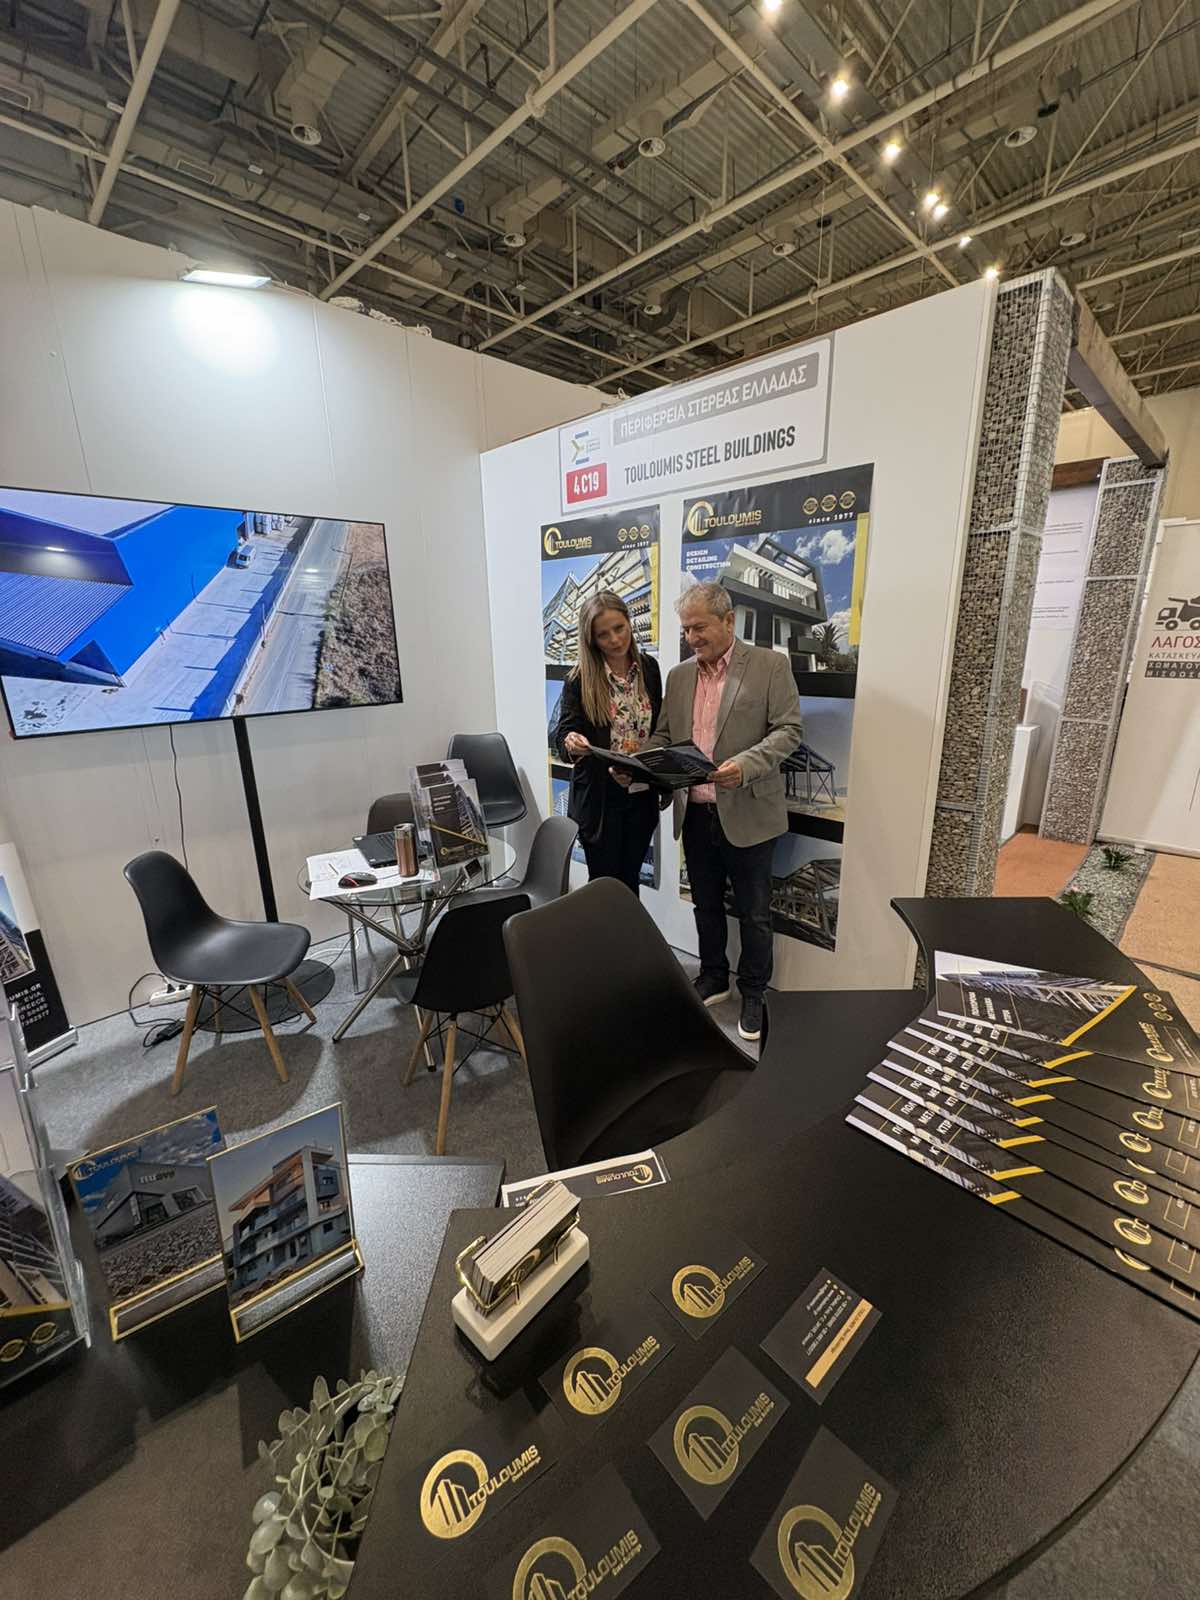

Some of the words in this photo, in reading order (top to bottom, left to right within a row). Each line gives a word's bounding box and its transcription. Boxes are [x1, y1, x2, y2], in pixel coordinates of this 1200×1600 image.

[620, 408, 686, 437] ΠΕΡΙΦΕΡΕΙΑ
[687, 387, 740, 417] ΣΤΕΡΕΑΣ
[742, 364, 808, 399] ΕΛΛΑΔΑΣ
[624, 454, 683, 485] TOULOUMIS
[685, 445, 720, 470] STEEL
[724, 425, 796, 462] BUILDINGS
[554, 536, 593, 549] TOULOUMIS
[703, 510, 762, 528] TOULOUMIS
[710, 1256, 751, 1298] TOULOUMIS
[605, 1335, 657, 1388] TOULOUMIS
[721, 1392, 770, 1453] TOULOUMIS
[469, 1444, 539, 1506] TOULOUMIS
[833, 1482, 876, 1566] TOULOUMIS
[567, 1529, 639, 1600] TOULOUMIS
